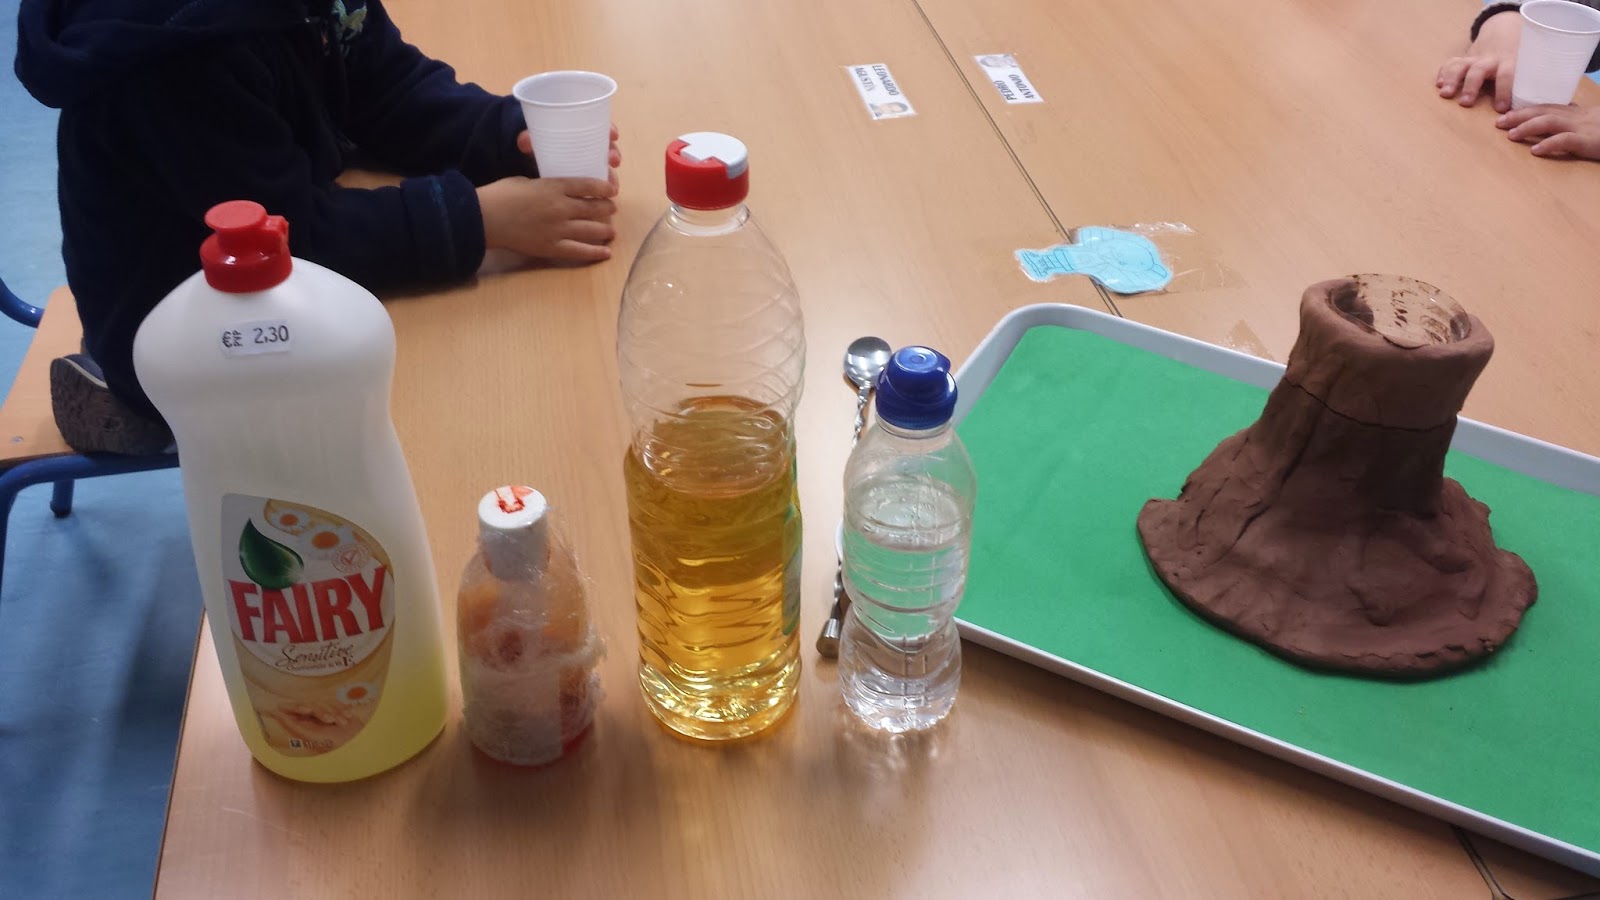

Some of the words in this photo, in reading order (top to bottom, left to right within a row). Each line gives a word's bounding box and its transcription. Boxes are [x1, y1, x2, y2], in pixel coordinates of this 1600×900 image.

[872, 64, 900, 96] LEONARDO
[993, 79, 1018, 101] PEDRO
[1008, 73, 1036, 100] ANTONIO
[252, 325, 289, 344] 2,30
[228, 565, 387, 643] FAIRY
[275, 641, 355, 667] Sensitive
